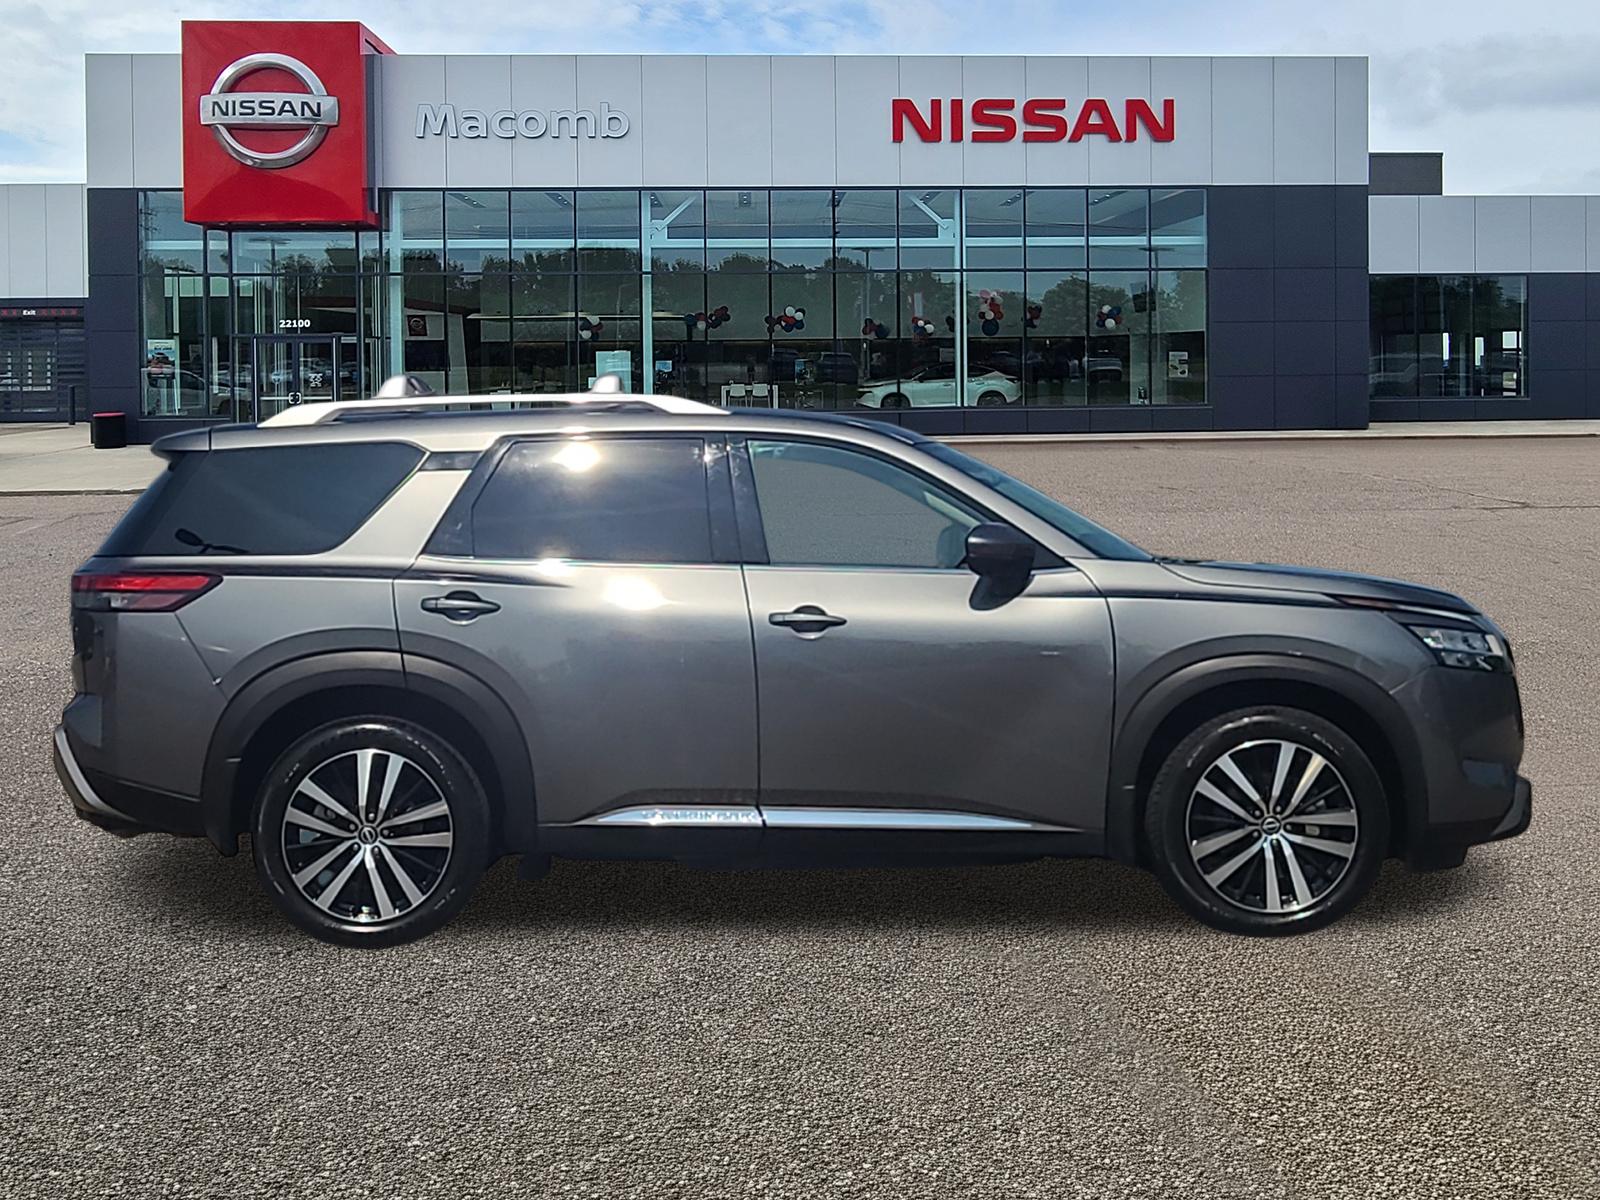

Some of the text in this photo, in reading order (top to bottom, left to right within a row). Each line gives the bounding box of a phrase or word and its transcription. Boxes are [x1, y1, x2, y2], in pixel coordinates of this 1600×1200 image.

[211, 100, 321, 117] NISSAN
[415, 102, 630, 139] Macomb
[892, 98, 1175, 142] NISSAN
[279, 319, 311, 328] 22100
